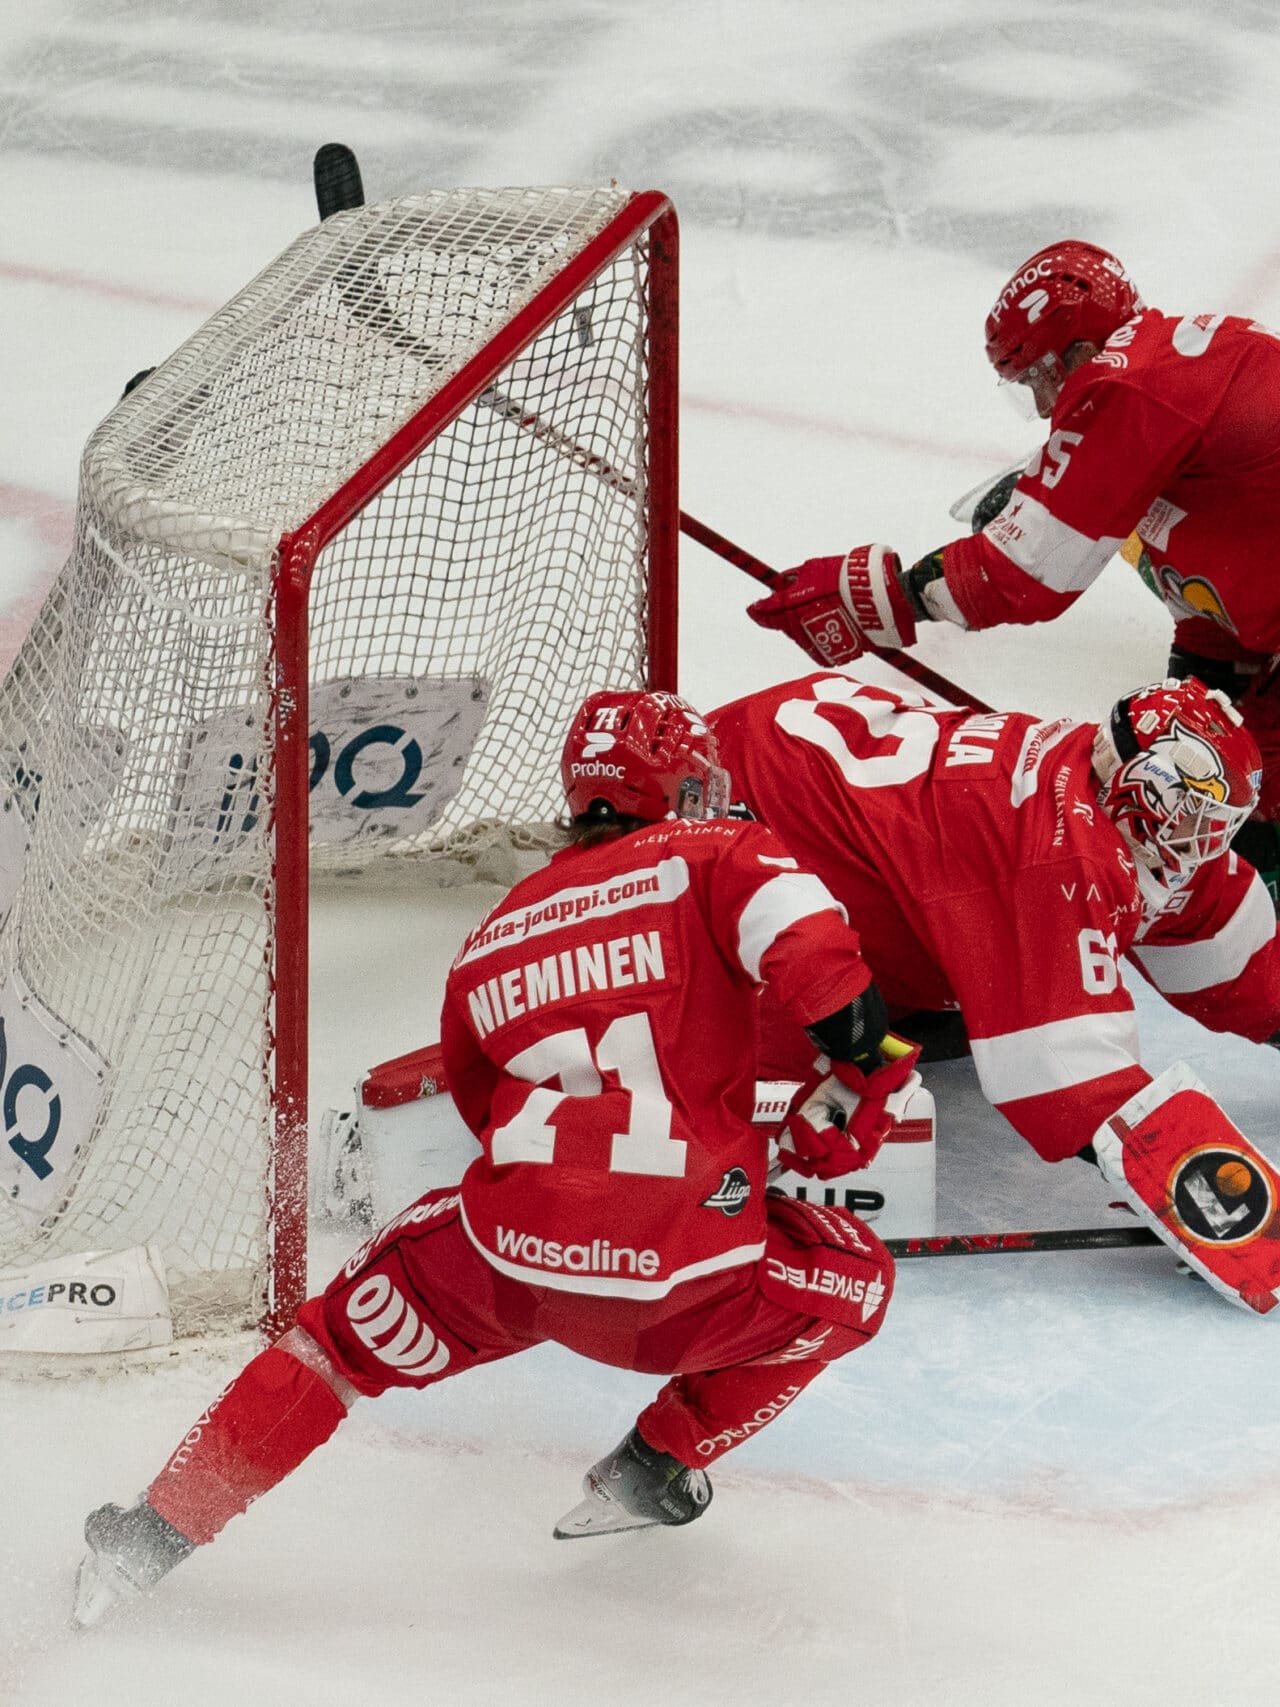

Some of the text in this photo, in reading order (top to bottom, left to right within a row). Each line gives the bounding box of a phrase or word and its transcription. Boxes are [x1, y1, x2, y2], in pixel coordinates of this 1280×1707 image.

[1023, 428, 1084, 490] 5
[593, 707, 618, 731] 71
[570, 759, 627, 780] Prohoc
[1142, 761, 1178, 784] VILPE
[466, 930, 667, 1041] NIEMINEN
[490, 1011, 689, 1178] 71
[710, 1173, 752, 1203] Liiga
[495, 1225, 661, 1276] wasaline
[0, 1282, 117, 1310] CEPRO
[766, 1257, 865, 1303] SYKETEC
[694, 1384, 801, 1456] movaco
